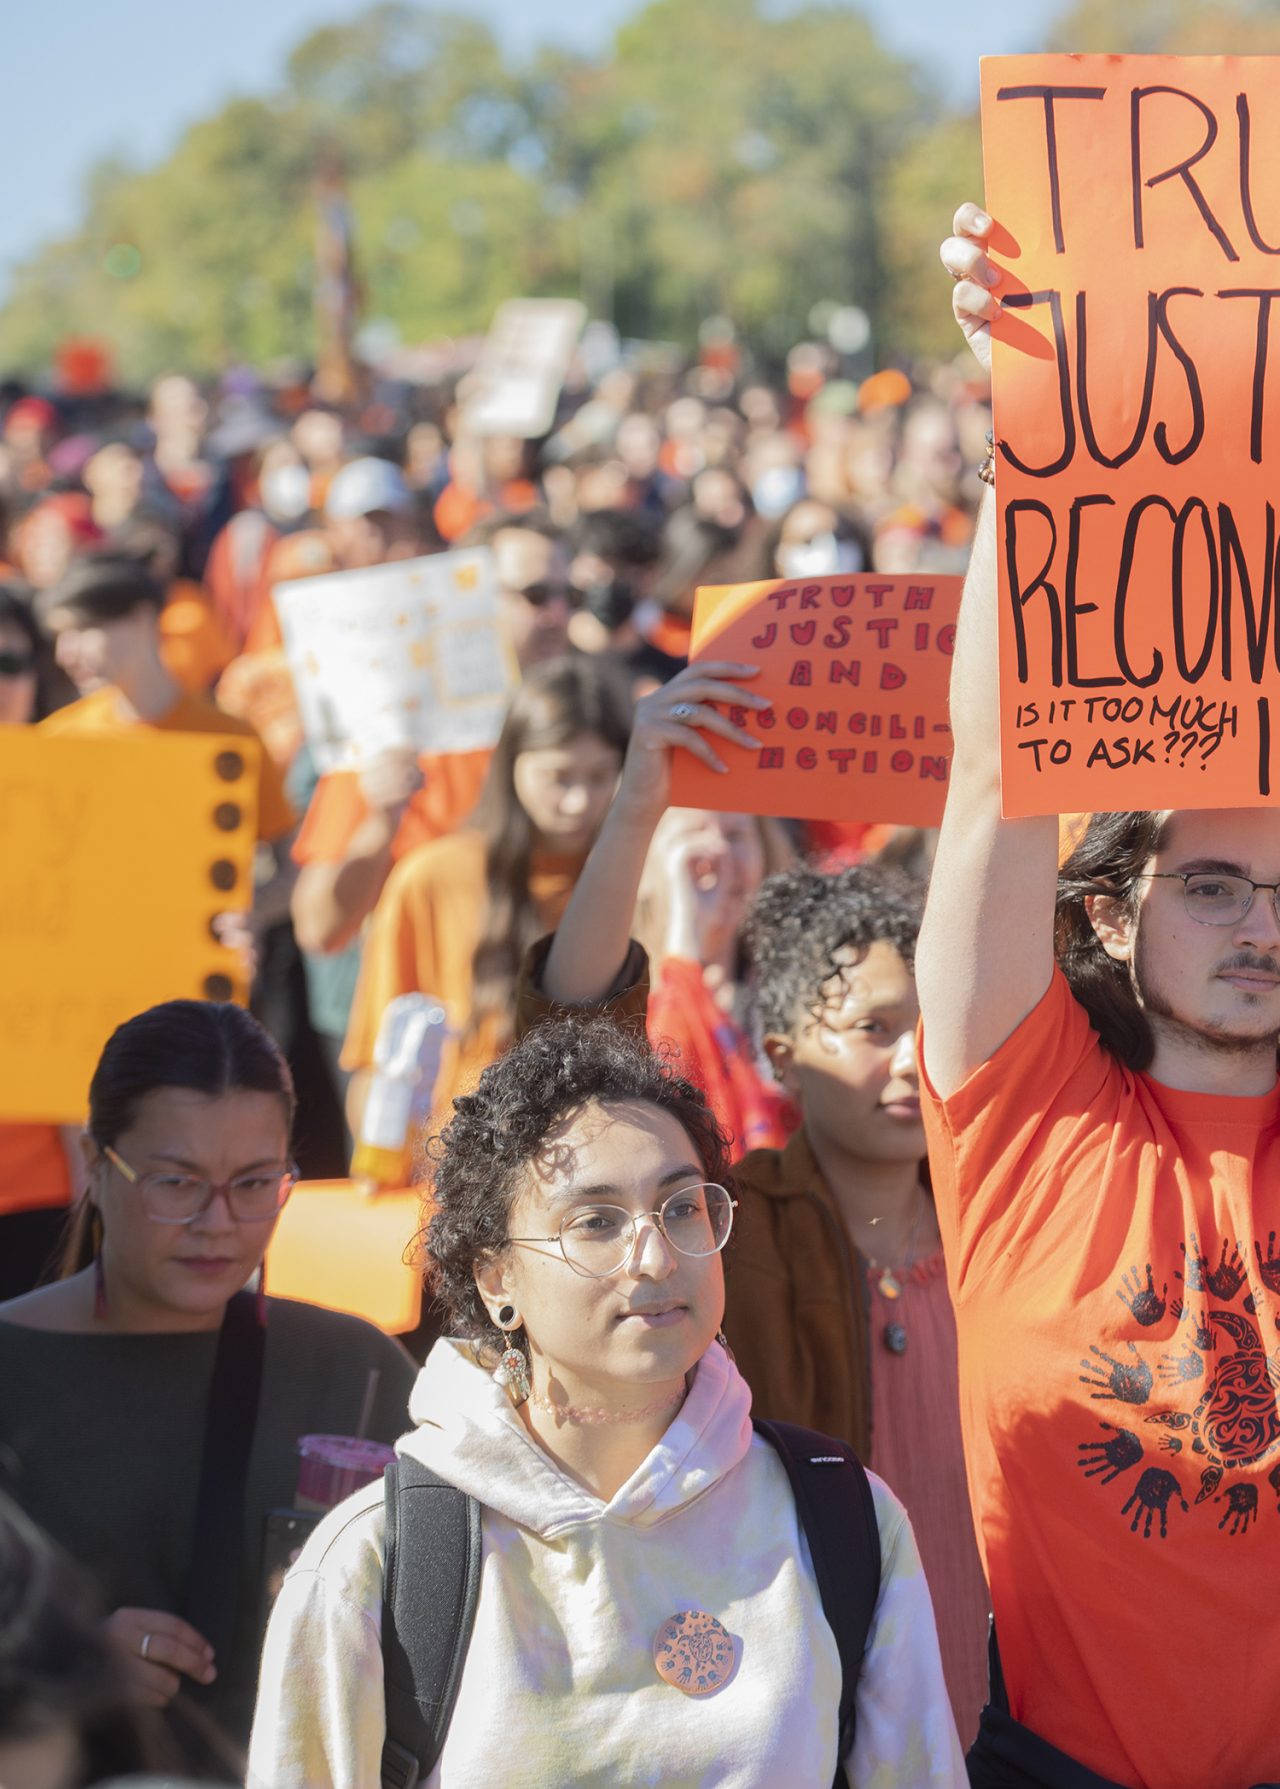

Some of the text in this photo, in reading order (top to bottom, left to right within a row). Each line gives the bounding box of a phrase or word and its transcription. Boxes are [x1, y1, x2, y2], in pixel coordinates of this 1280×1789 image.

[767, 584, 935, 611] TRUTH
[752, 615, 957, 656] JUSTIC
[789, 660, 907, 690] AND
[1016, 695, 1237, 738] IS IT TOO MUCH
[758, 746, 947, 781] ACTION
[1017, 731, 1222, 772] TO ASK???
